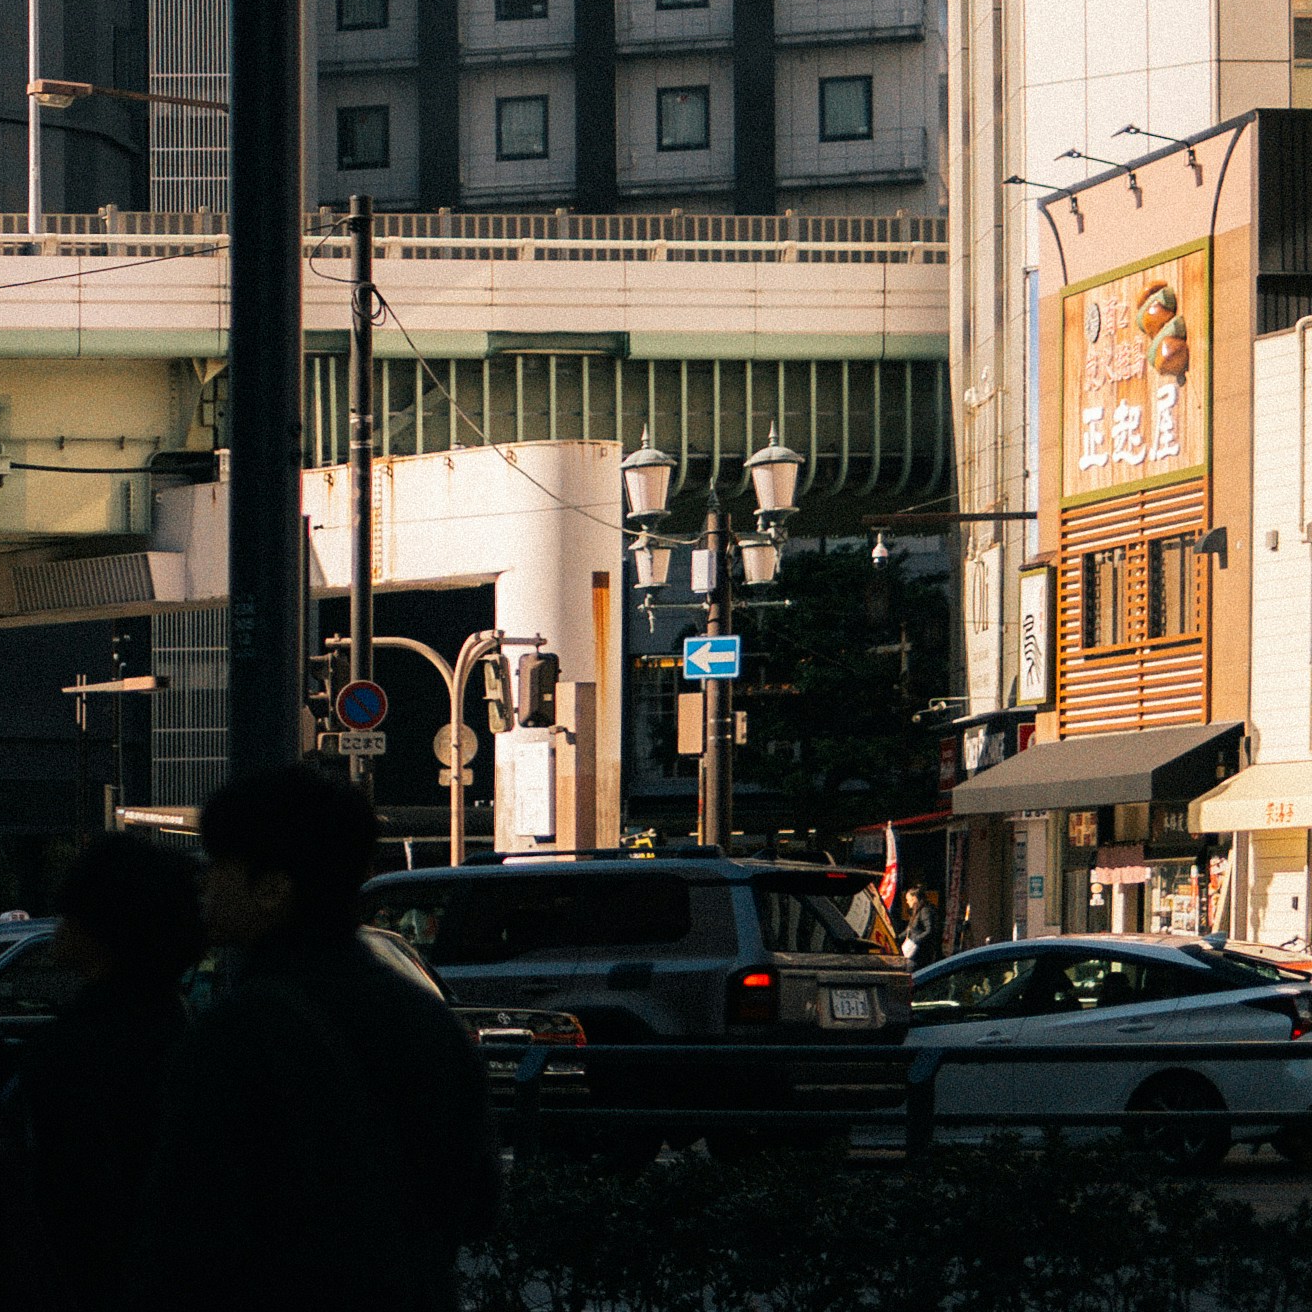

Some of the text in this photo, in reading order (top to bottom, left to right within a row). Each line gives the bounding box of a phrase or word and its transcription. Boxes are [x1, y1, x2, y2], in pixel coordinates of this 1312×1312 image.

[1079, 382, 1181, 471] 正起屋
[342, 737, 384, 750] ここまで
